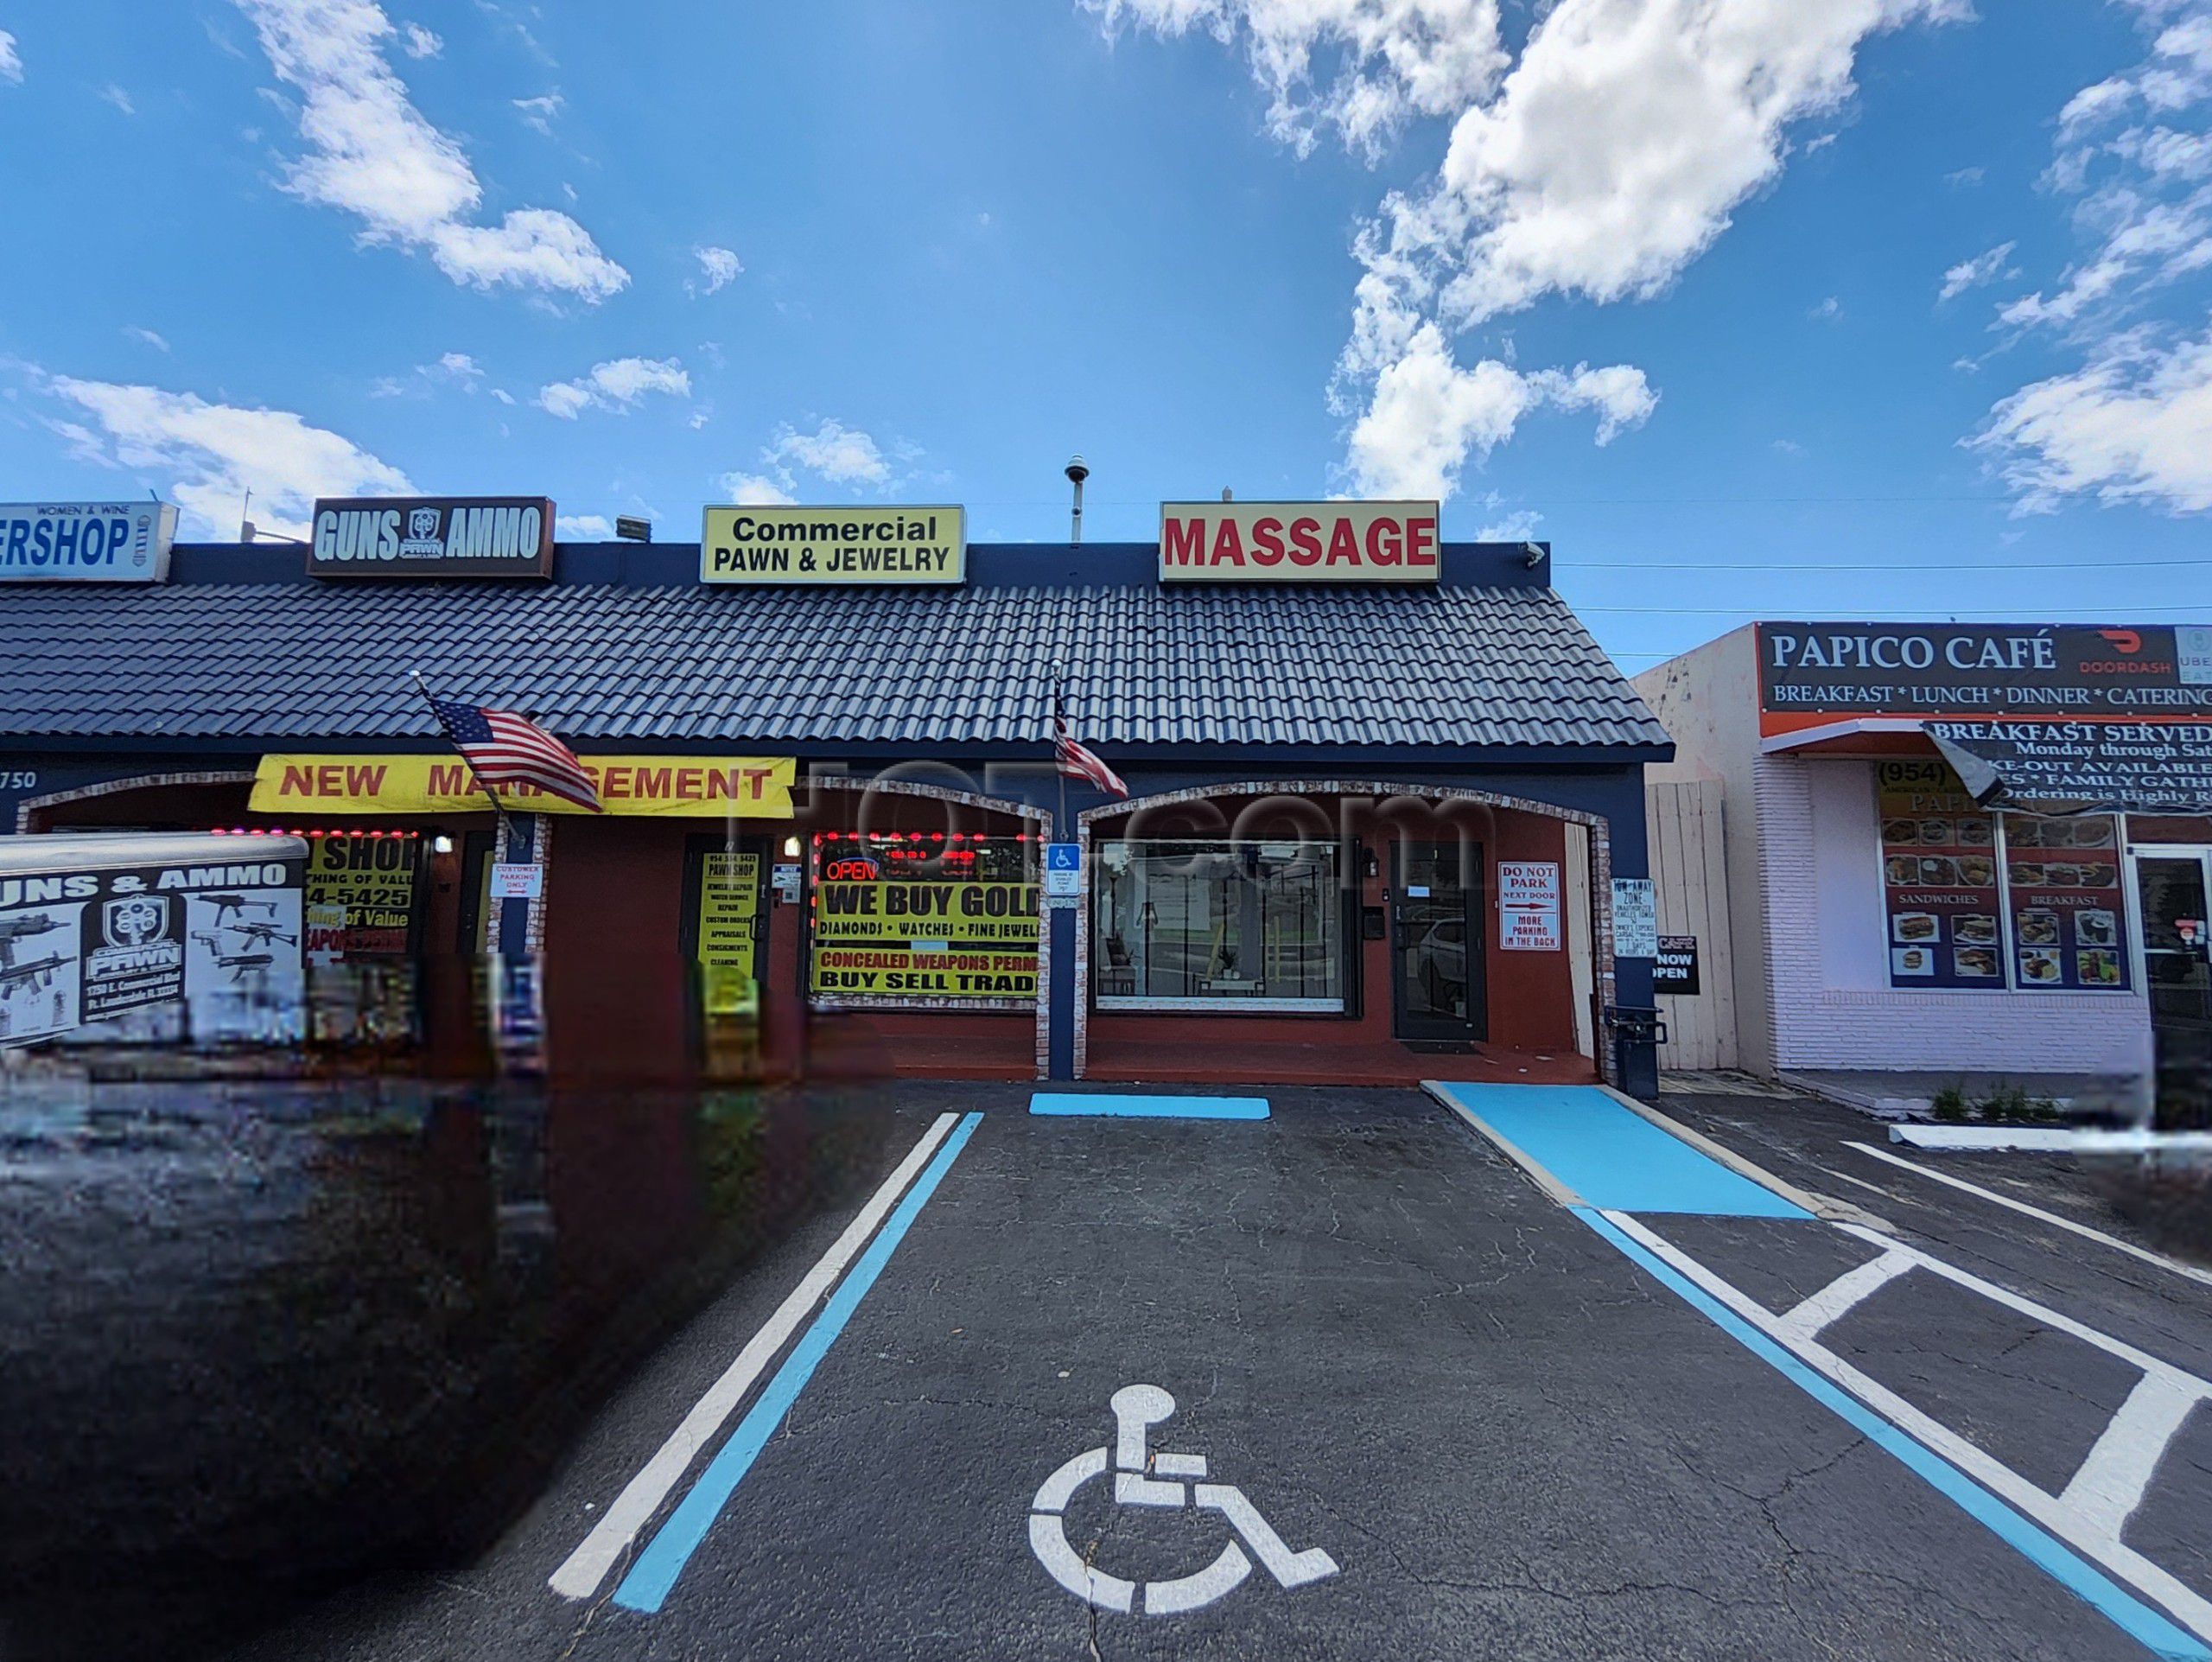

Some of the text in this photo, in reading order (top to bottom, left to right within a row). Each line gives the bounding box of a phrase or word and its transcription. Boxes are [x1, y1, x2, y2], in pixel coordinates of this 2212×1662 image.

[37, 505, 130, 515] WOMEN & WINE
[314, 506, 541, 561] GUNS AMMO
[733, 516, 936, 541] Commercial
[1164, 518, 1436, 566] MASSAGE
[714, 547, 950, 572] PAWN & JEWELRY
[1771, 628, 2056, 669] PAPICO CAFÉ
[2079, 661, 2171, 674] DOORDASH
[1773, 685, 1893, 702] BREAKFAST
[1911, 686, 1990, 704] LUNCH
[2006, 688, 2091, 704] DINNER
[1931, 723, 2212, 742] BREAKFAST SERVED
[2015, 742, 2094, 760] Monday
[2100, 742, 2178, 761] through
[1879, 761, 1945, 786] (954)
[2081, 761, 2212, 774] AVAILABLE
[278, 765, 773, 799] NEW MEMENT
[2045, 774, 2135, 786] FAMILY
[2140, 776, 2212, 787] GATH
[2097, 788, 2116, 799] is
[2120, 789, 2190, 805] Highly
[111, 875, 148, 894] &
[156, 863, 286, 889] AMMO
[733, 863, 754, 876] SHOP
[827, 862, 876, 880] OPEN
[1503, 867, 1554, 877] DO NOT
[354, 874, 372, 884] OF
[1510, 878, 1548, 888] PARK
[825, 884, 878, 915] WE
[886, 885, 954, 916] BUY
[1624, 892, 1643, 905] ZONE
[1899, 894, 1979, 905] SANDWICHES
[2031, 895, 2099, 906] BREAKFAST
[346, 908, 361, 925] of
[365, 909, 409, 927] Value
[1517, 916, 1542, 926] MORE
[820, 921, 1039, 939] DIAMONDS WATCHES FINE JEWEL
[1512, 926, 1548, 936] PARKING
[1505, 937, 1555, 947] IN THE BACK
[89, 946, 180, 977] PAWN
[820, 952, 908, 970] CONCEALED
[912, 953, 989, 971] WEAPONS
[1656, 953, 1693, 965] NOW
[820, 971, 1038, 992] BUY SELL TRAD
